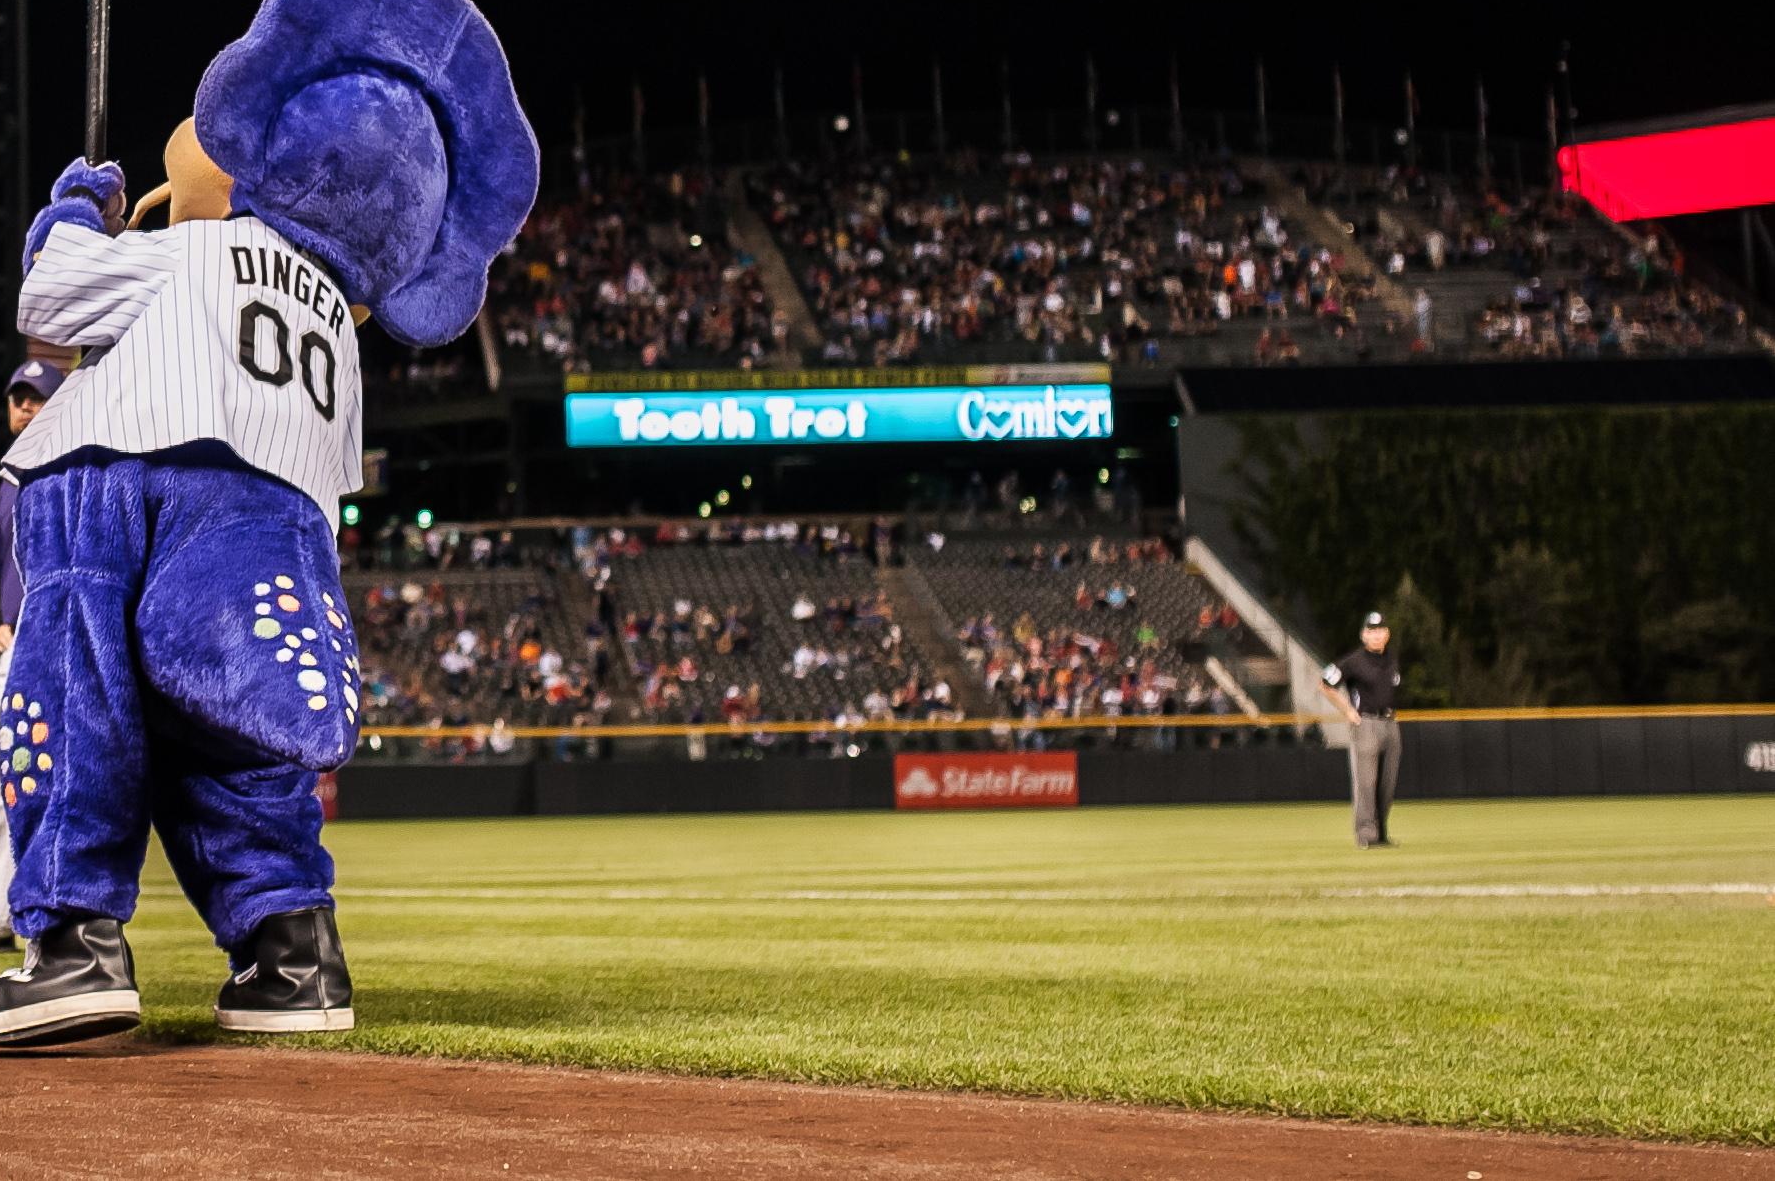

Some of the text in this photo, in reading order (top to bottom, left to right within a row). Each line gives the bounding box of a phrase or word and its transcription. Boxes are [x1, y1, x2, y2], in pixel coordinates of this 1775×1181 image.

[230, 246, 346, 338] DINGER
[238, 299, 337, 423] 00
[614, 395, 756, 441] Tooth
[765, 395, 868, 438] Trot
[942, 765, 1075, 798] State Farm
